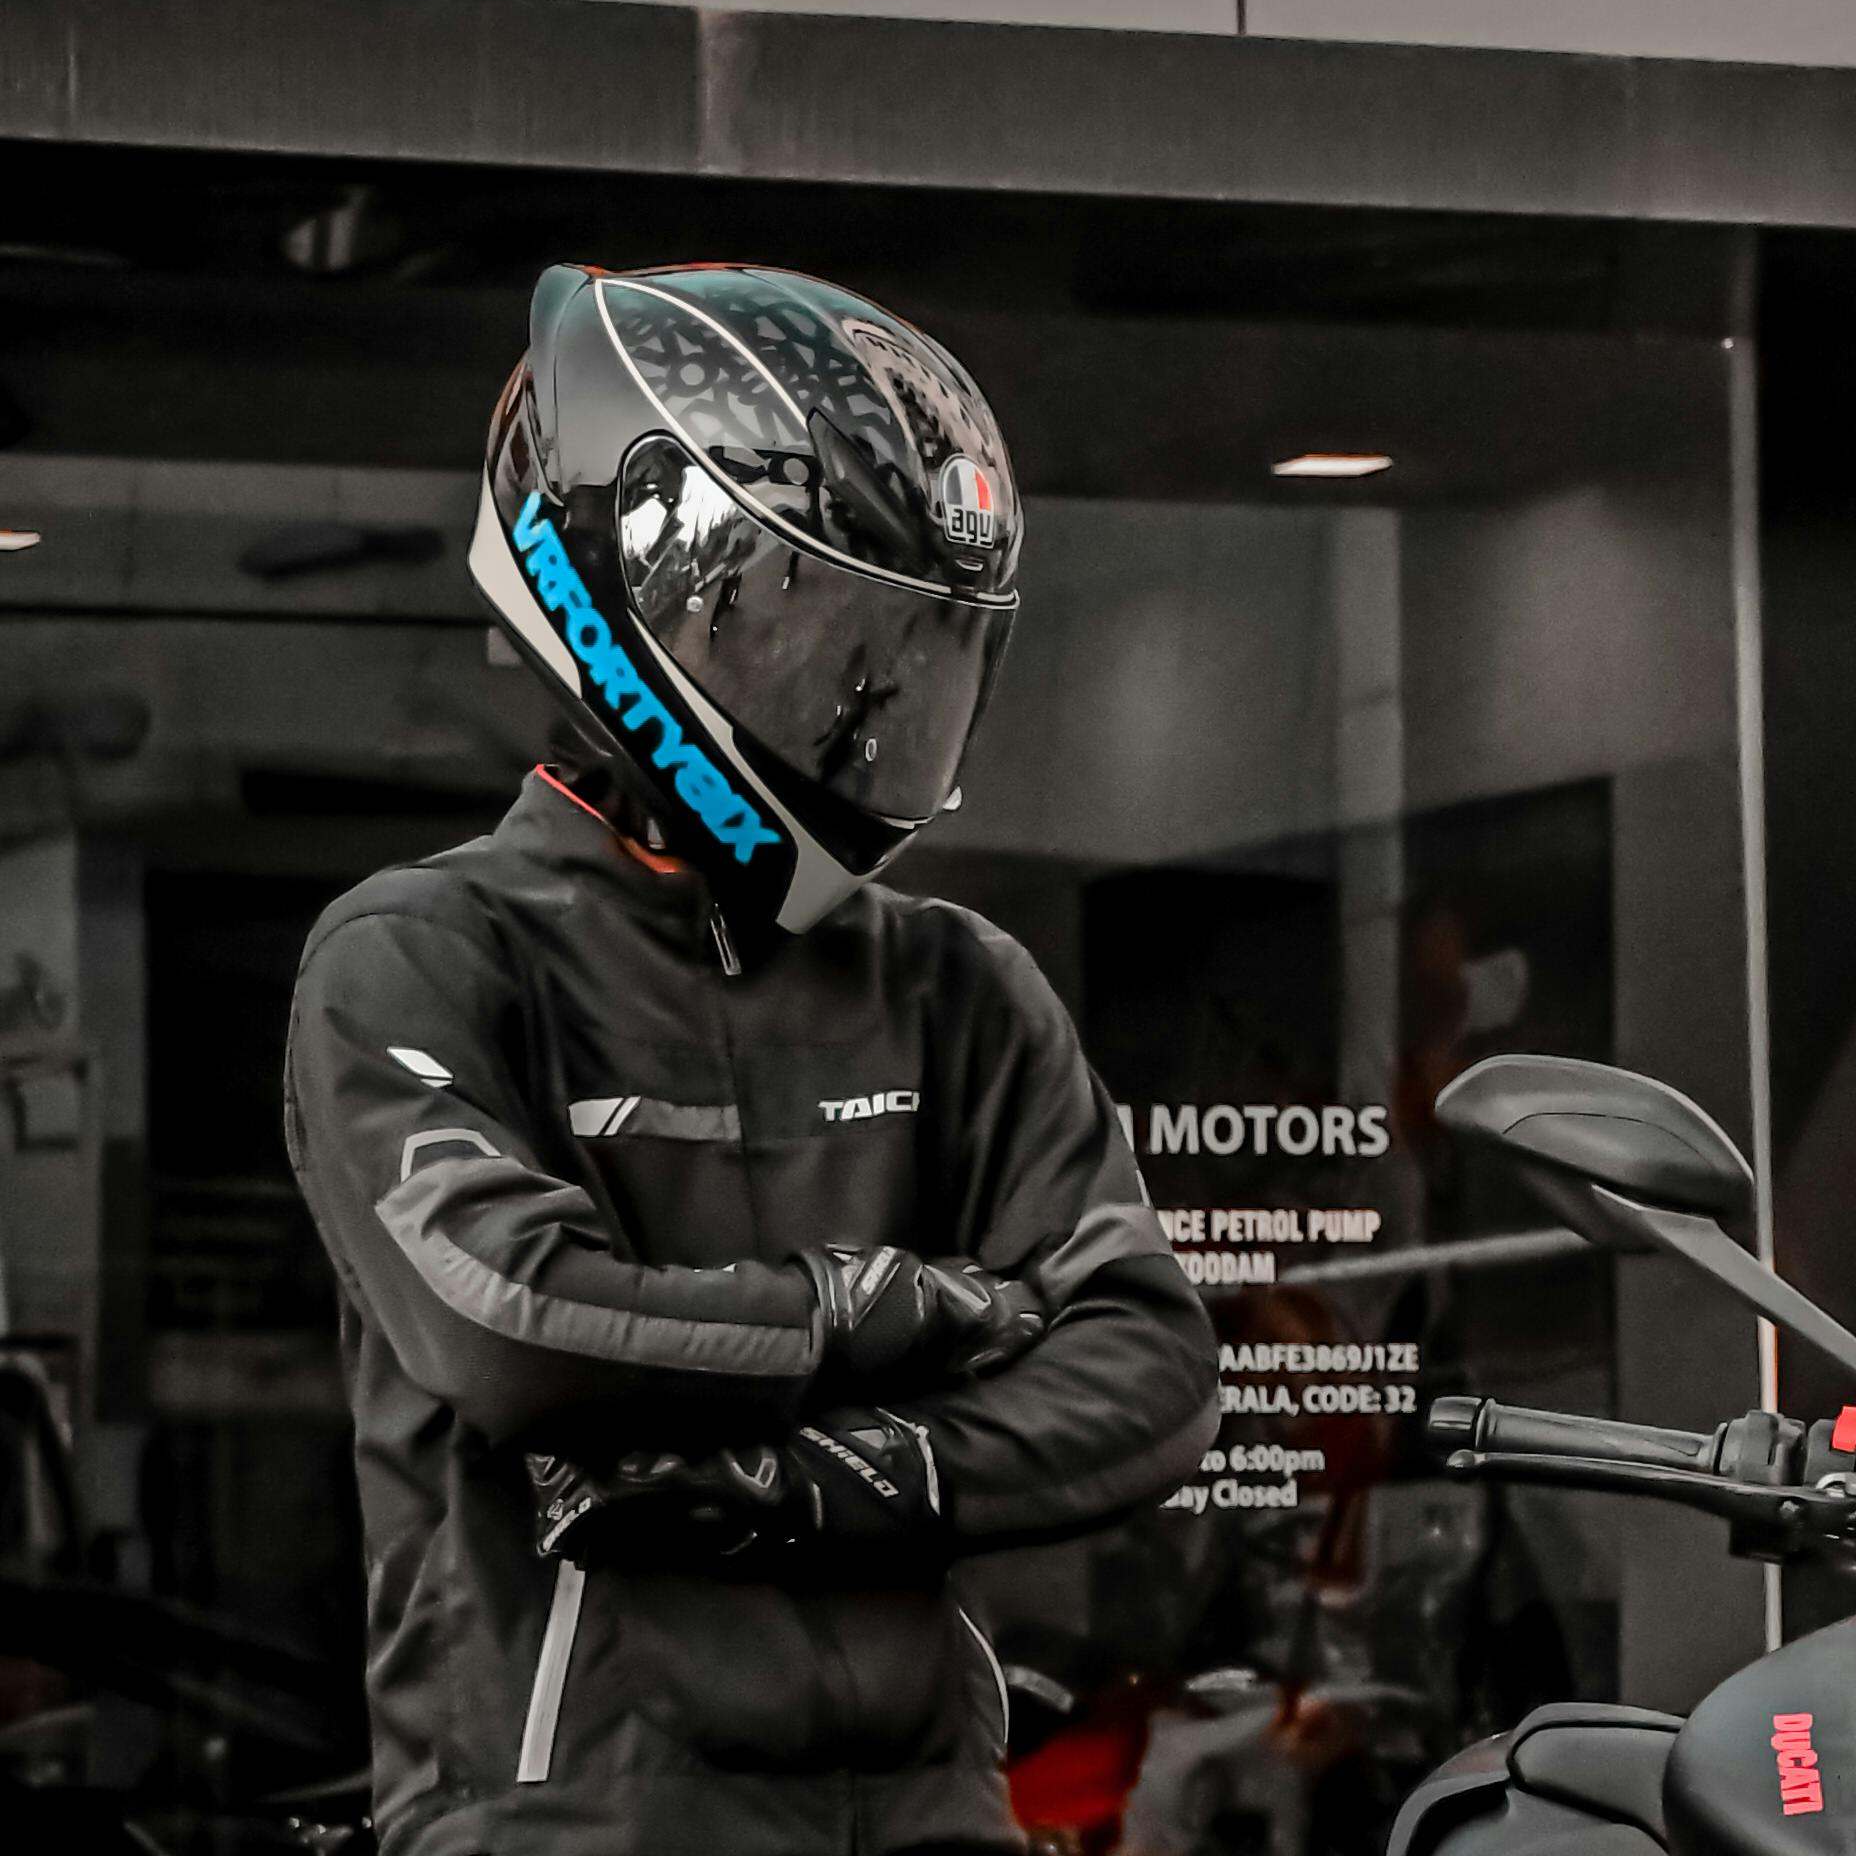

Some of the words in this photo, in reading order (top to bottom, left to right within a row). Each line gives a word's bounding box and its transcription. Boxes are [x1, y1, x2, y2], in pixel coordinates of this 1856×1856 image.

[1149, 1103, 1390, 1157] MOTORS
[1210, 1209, 1304, 1242] PETROL
[1307, 1209, 1382, 1242] PUMP
[1302, 1384, 1382, 1413] CODE:
[1384, 1384, 1418, 1414] 32
[1229, 1445, 1326, 1478] 6:00pm
[1211, 1478, 1299, 1509] Closed
[1770, 1712, 1824, 1816] DUCATI
